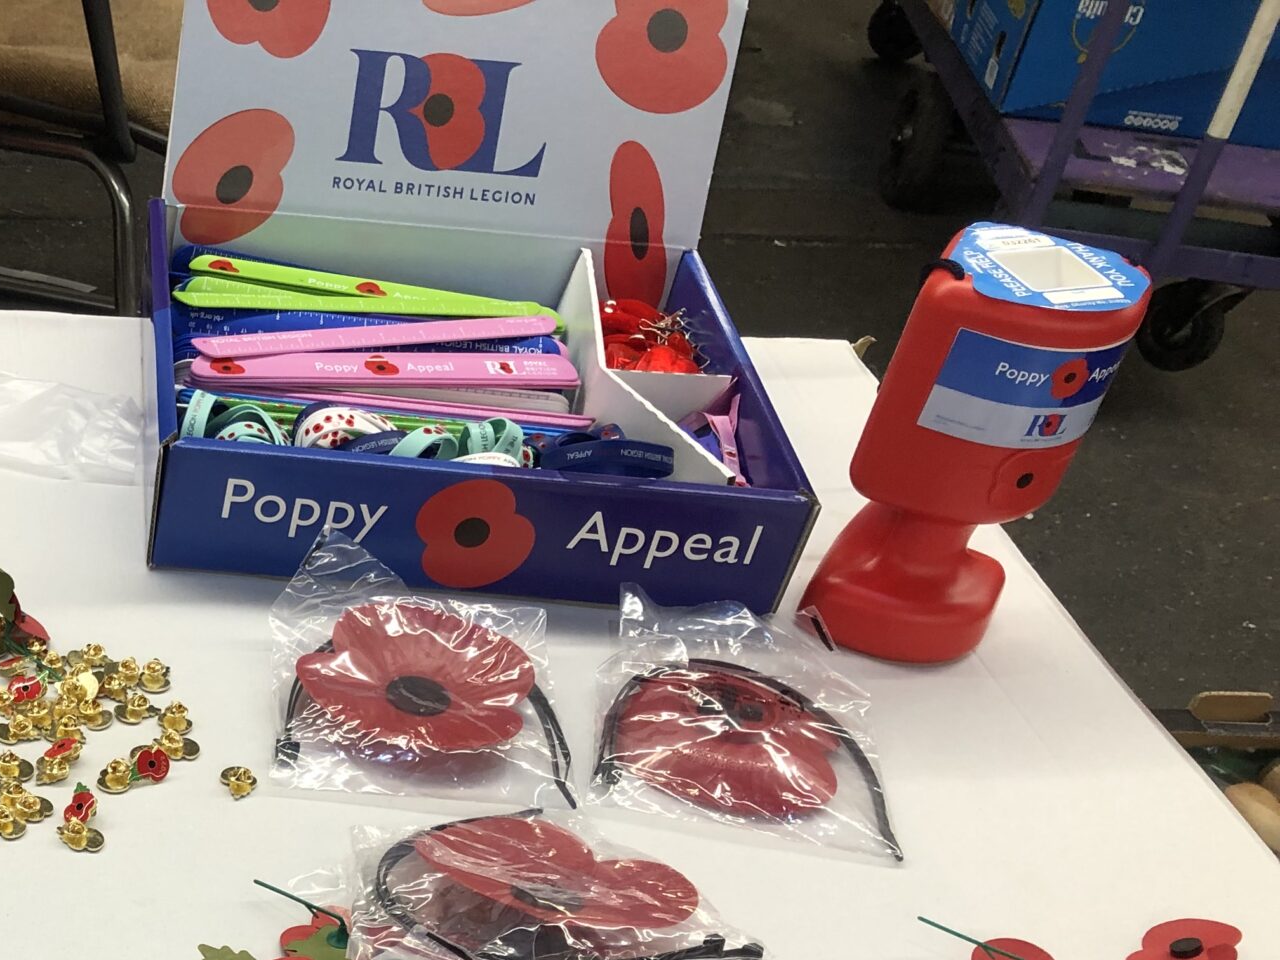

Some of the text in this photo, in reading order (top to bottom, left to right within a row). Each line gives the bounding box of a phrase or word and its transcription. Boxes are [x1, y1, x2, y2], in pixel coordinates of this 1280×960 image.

[332, 176, 537, 206] ROYAL BRITISH LEGION
[1066, 242, 1135, 288] THANK YOU
[308, 277, 350, 291] Poppy
[314, 361, 455, 374] Poppy Appeal
[995, 361, 1051, 387] Poppy
[220, 477, 763, 570] Poppy Appeal
